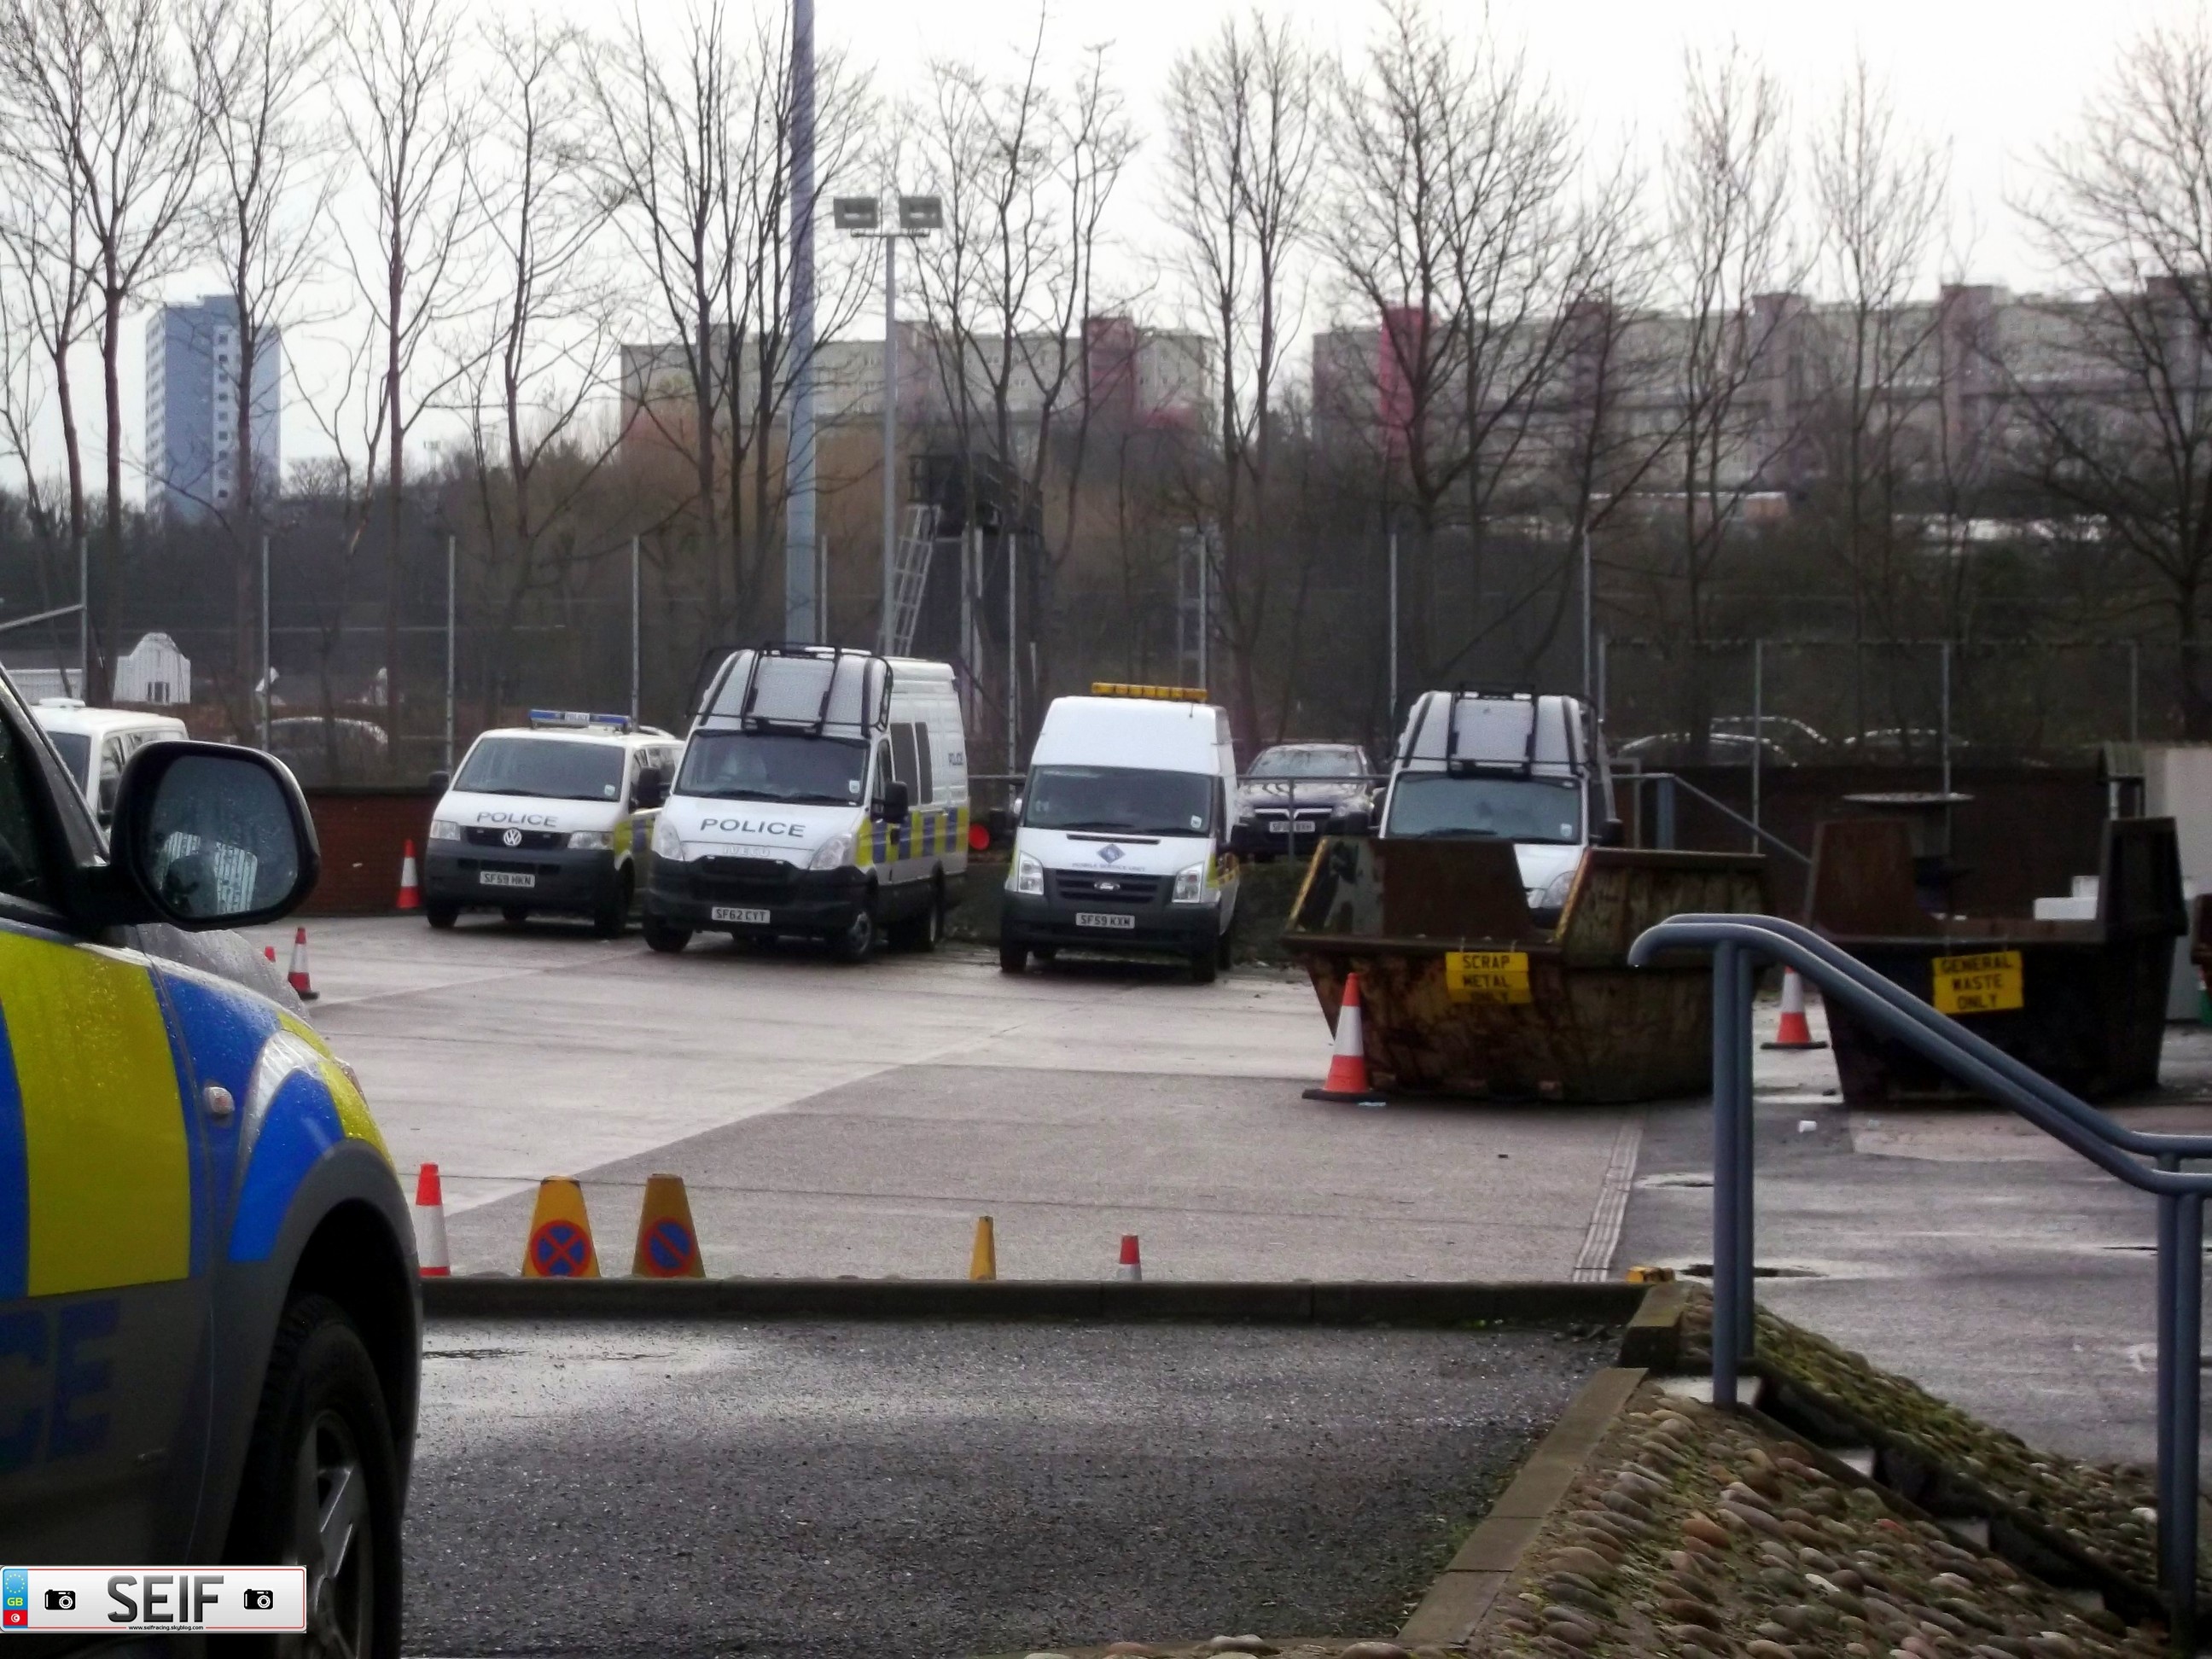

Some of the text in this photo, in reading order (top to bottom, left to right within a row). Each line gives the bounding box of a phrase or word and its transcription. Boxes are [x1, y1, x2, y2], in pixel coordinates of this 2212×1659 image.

[477, 812, 559, 828] POLICE
[700, 818, 806, 838] POLICE
[716, 908, 766, 922] SF62 CYT
[1080, 915, 1108, 927] SF59
[1463, 955, 1511, 969] SCRAP
[1940, 954, 2012, 973] GENERAL
[1463, 973, 1512, 988] METAL
[1952, 973, 2002, 991] WASTE
[1958, 992, 1998, 1010] ONLY
